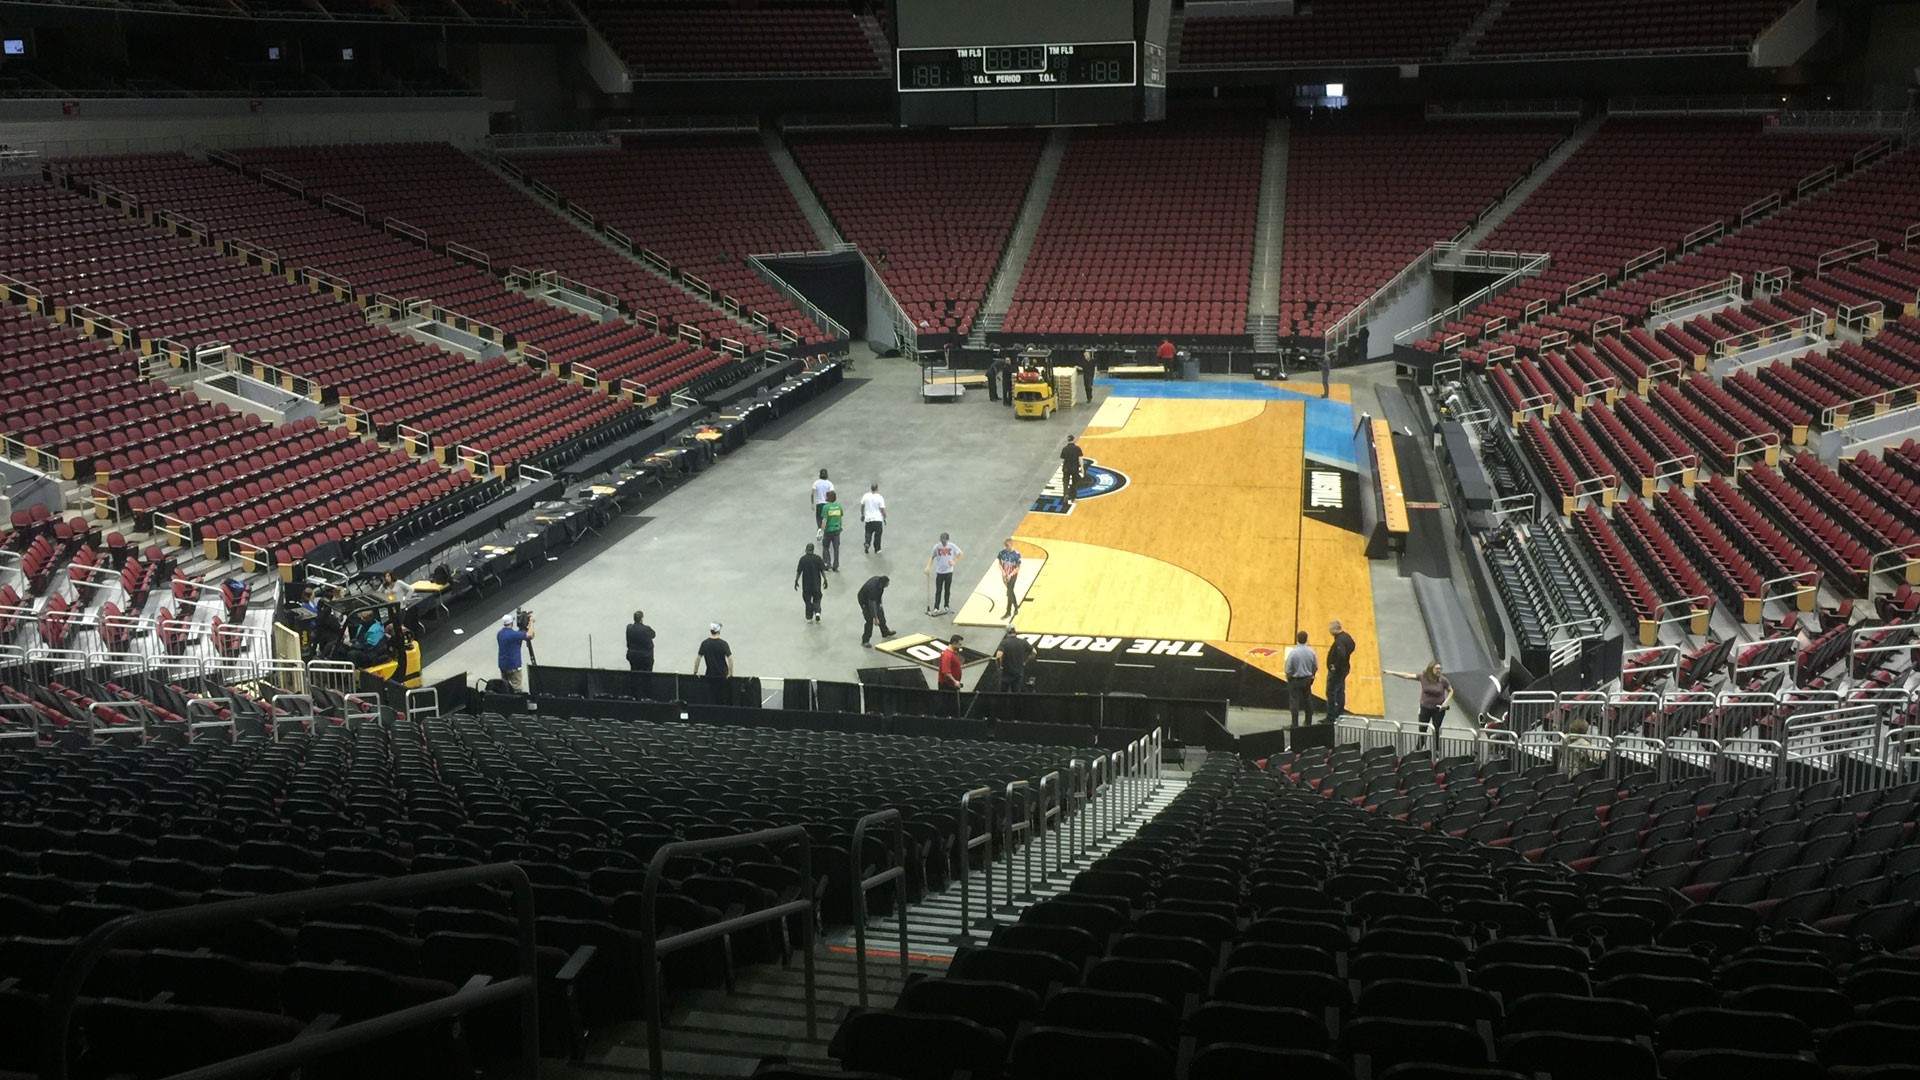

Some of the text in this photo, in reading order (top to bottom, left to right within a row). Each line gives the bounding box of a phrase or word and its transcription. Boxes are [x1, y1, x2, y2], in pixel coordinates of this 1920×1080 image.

[956, 48, 982, 58] TM FLS
[1048, 45, 1074, 55] TM FLS
[995, 74, 1021, 83] PERIOD
[1126, 638, 1204, 657] THE
